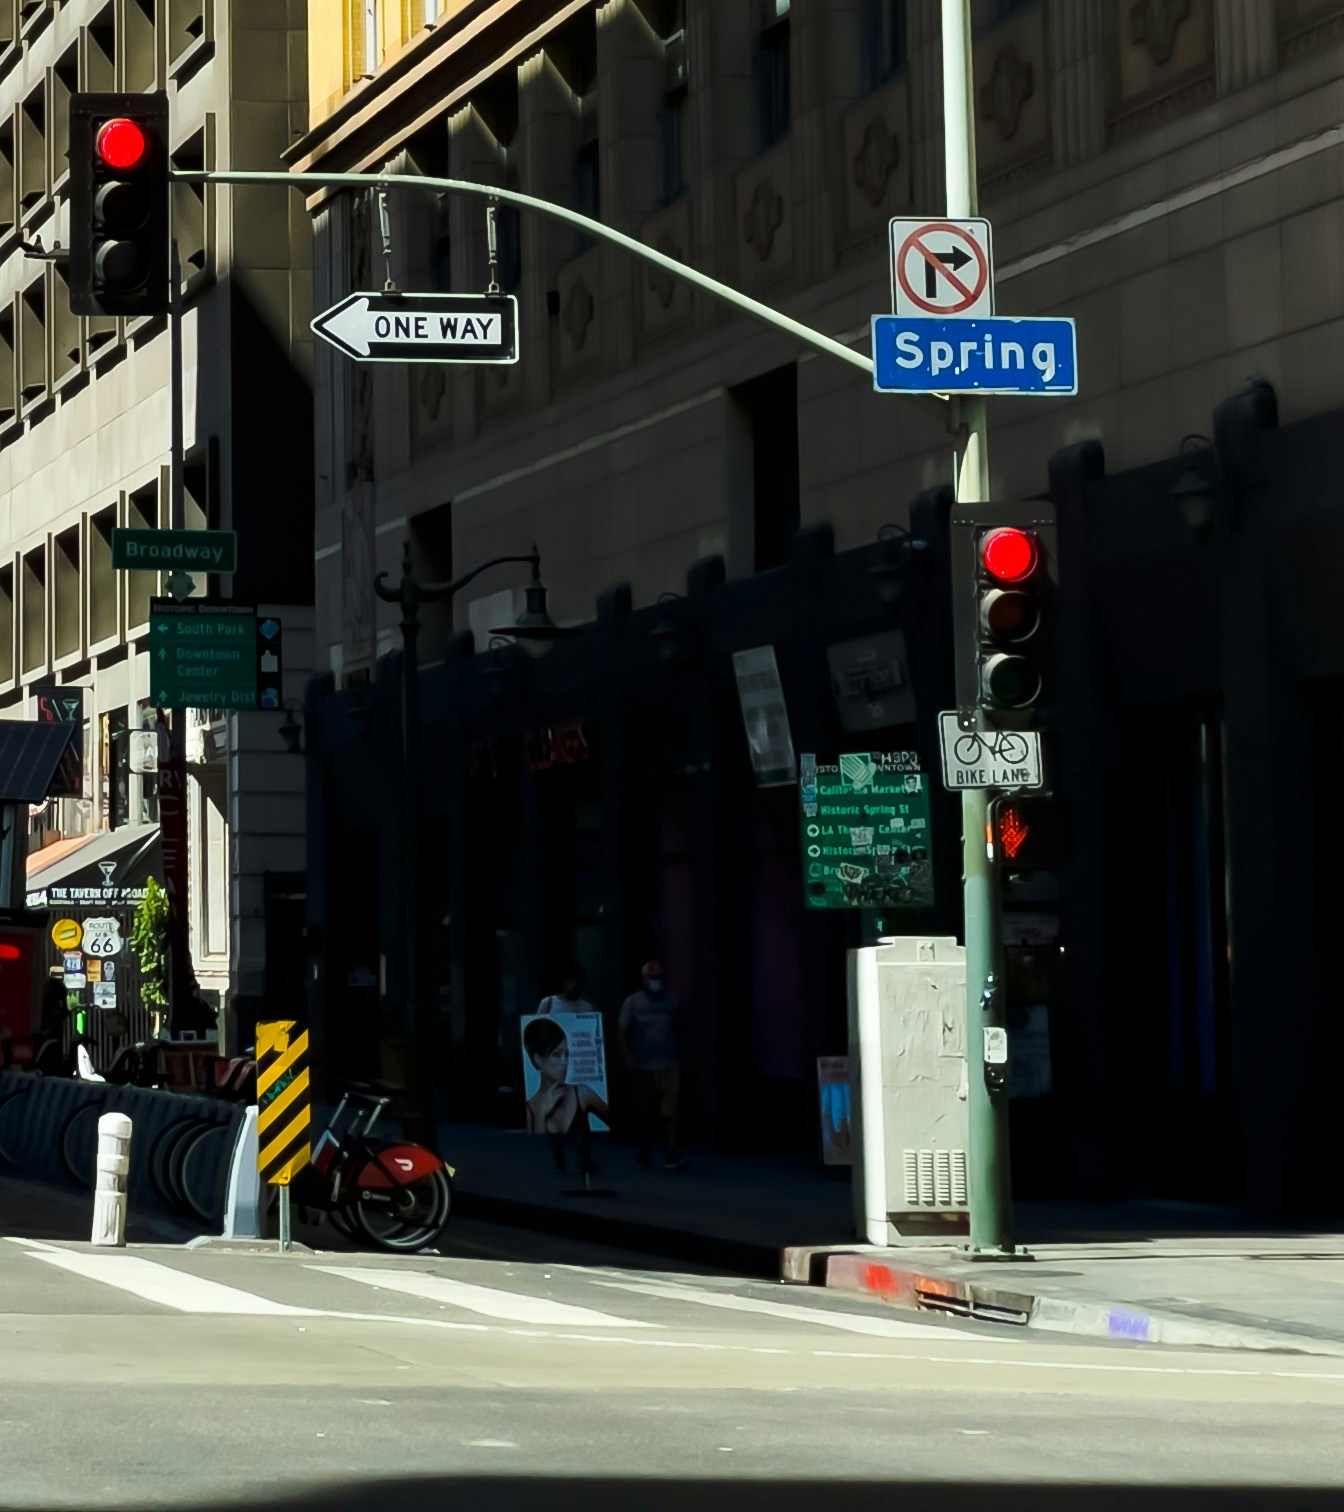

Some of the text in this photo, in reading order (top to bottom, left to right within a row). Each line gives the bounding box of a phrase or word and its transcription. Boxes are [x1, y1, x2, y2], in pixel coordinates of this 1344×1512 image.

[375, 316, 494, 340] ONE WAY
[896, 332, 1056, 382] Spring
[125, 541, 223, 563] Broadway
[176, 623, 245, 635] South Park
[176, 648, 240, 661] Downtown
[177, 663, 220, 677] Center
[177, 690, 256, 704] Jewelry Dist
[956, 768, 1030, 785] BIKE LANE
[871, 784, 906, 794] Market
[820, 804, 910, 817] Historic Spring St
[821, 825, 834, 836] LA
[51, 887, 68, 898] THE
[69, 887, 102, 898] TAVERN
[102, 887, 119, 898] OFF
[88, 922, 113, 930] ROUTE
[90, 937, 114, 954] 66
